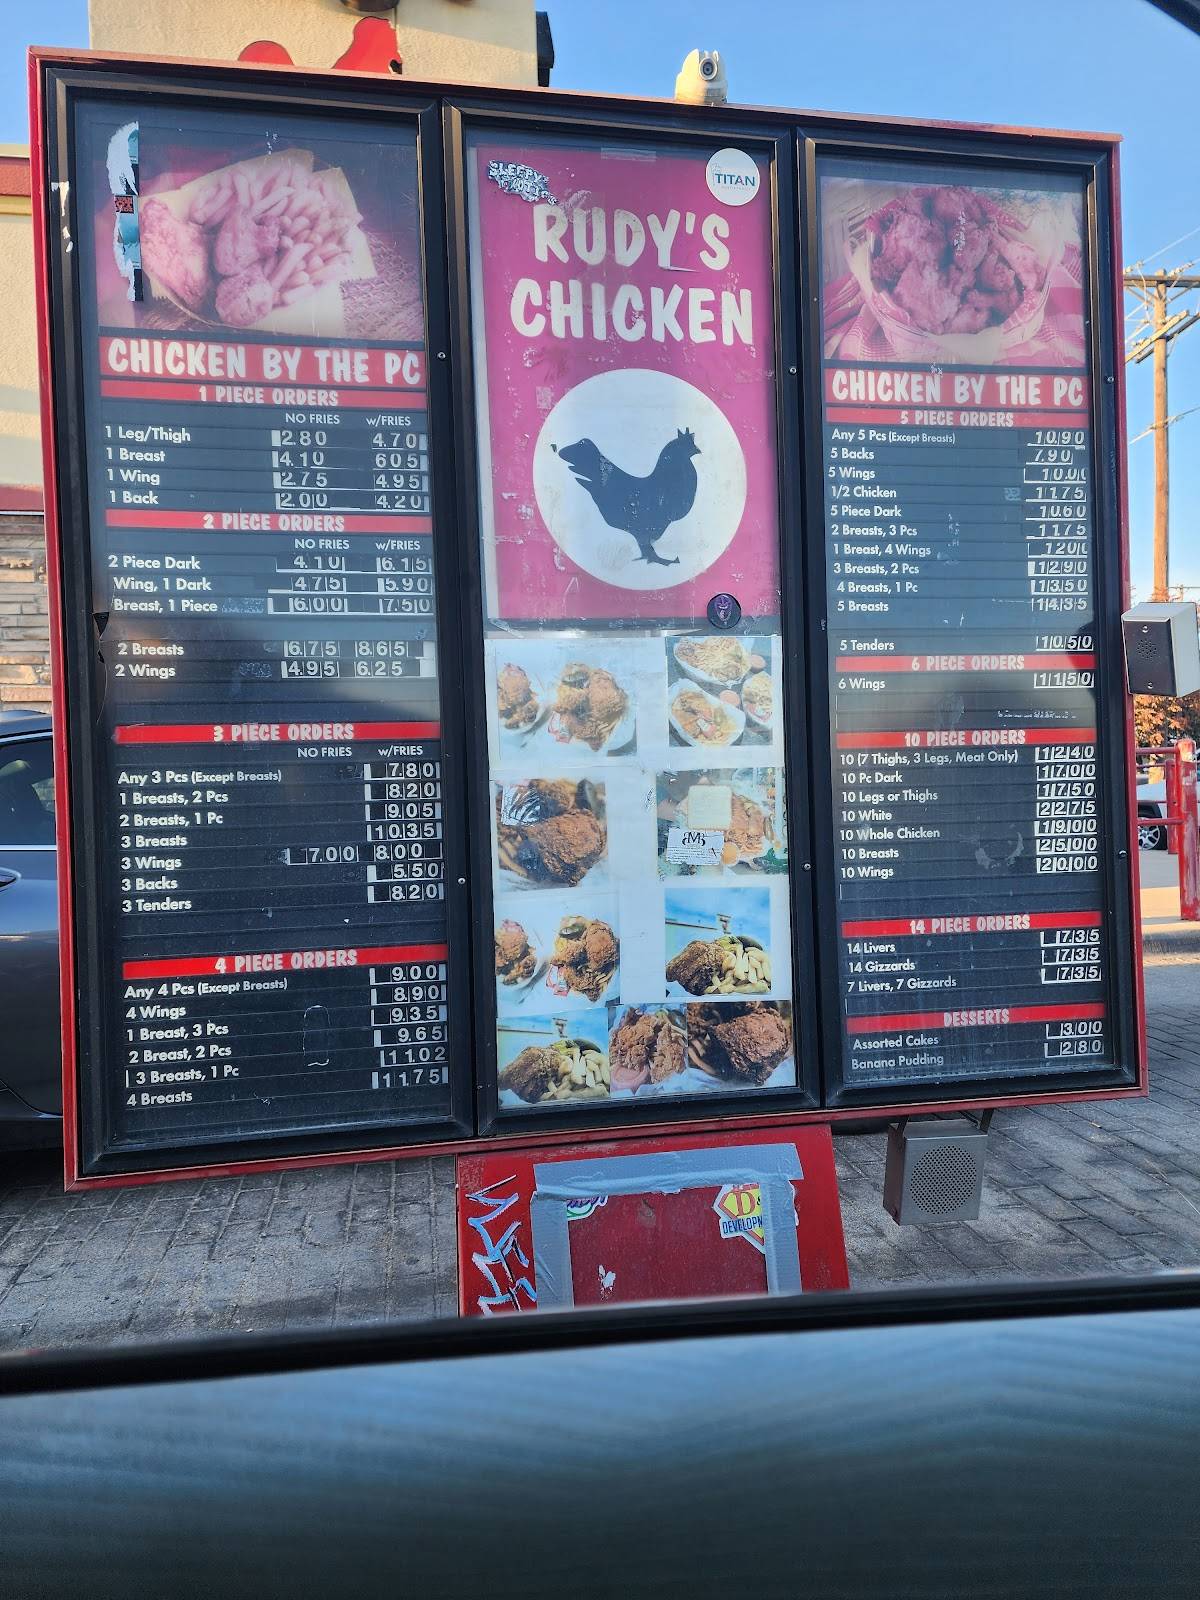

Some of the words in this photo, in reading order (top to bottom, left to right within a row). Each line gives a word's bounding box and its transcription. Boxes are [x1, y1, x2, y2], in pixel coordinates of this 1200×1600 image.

[715, 174, 755, 186] TITAN
[533, 204, 731, 271] RUDY'S
[510, 278, 754, 345] CHICKEN
[108, 338, 246, 379] CHICKEN
[262, 348, 301, 381] BY
[314, 350, 370, 383] THE
[384, 352, 421, 385] PC
[199, 385, 208, 401] 1
[216, 386, 264, 404] PIECE
[272, 388, 339, 407] ORDERS
[832, 371, 942, 403] CHICKEN
[955, 375, 985, 404] BY
[997, 377, 1041, 405] THE
[1054, 378, 1083, 406] PC
[285, 413, 306, 424] NO
[310, 414, 340, 425] FRIES
[366, 415, 411, 427] w/FRIES
[901, 412, 908, 425] 5
[915, 411, 954, 425] PIECE
[960, 412, 1013, 427] ORDERS
[106, 426, 112, 438] 1
[118, 426, 191, 442] Leg/Thigh
[831, 429, 855, 443] Any
[858, 430, 866, 441] 5
[870, 430, 886, 441] Pcs
[888, 432, 920, 444] (Except
[922, 432, 956, 443] Breasts)
[107, 448, 112, 459] 1
[120, 448, 165, 462] Breast
[108, 469, 114, 481] 1
[120, 470, 160, 485] Wing
[110, 491, 116, 502] 1
[122, 491, 158, 504] Back
[831, 486, 850, 498] 1/2
[854, 486, 896, 499] Chicken
[831, 506, 838, 516] 5
[842, 506, 871, 517] Piece
[874, 506, 902, 517] Dark
[203, 514, 214, 529] 2
[222, 513, 271, 530] PIECE
[278, 514, 345, 532] ORDERS
[295, 539, 315, 550] NO
[319, 539, 349, 550] FRIES
[375, 540, 420, 551] w/FRIES
[108, 556, 118, 568] 2
[123, 556, 161, 569] Piece
[165, 557, 200, 569] Dark
[113, 578, 158, 592] Wing,
[164, 578, 170, 590] 1
[176, 578, 211, 591] Dark
[118, 644, 128, 656] 2
[132, 643, 184, 656] Breasts
[912, 658, 920, 670] 6
[927, 656, 965, 670] PIECE
[971, 655, 1024, 670] ORDERS
[115, 664, 125, 676] 2
[129, 664, 175, 679] Wings
[839, 679, 846, 689] 6
[850, 678, 885, 691] Wings
[213, 727, 224, 741] 3
[231, 726, 279, 741] PIECE
[288, 725, 354, 740] ORDERS
[905, 733, 919, 746] 10
[927, 732, 965, 746] PIECE
[972, 730, 1025, 745] ORDERS
[298, 748, 318, 758] NO
[321, 747, 352, 757] FRIES
[378, 745, 423, 757] w/FRIES
[840, 754, 854, 765] 10
[857, 752, 869, 766] (7
[872, 752, 910, 765] Thighs,
[914, 753, 921, 763] 3
[924, 752, 952, 765] Legs,
[955, 752, 985, 763] Meat
[988, 750, 1019, 763] Only)
[118, 771, 148, 785] Any
[152, 772, 161, 783] 3
[165, 771, 188, 783] Pcs
[192, 771, 234, 784] (Except
[237, 770, 281, 782] Breasts)
[120, 793, 125, 804] 1
[132, 792, 188, 805] Breasts,
[193, 792, 202, 803] 2
[206, 792, 228, 803] Pcs
[841, 792, 855, 803] 10
[859, 791, 885, 804] Legs
[888, 793, 900, 802] or
[902, 790, 938, 802] Thighs
[841, 810, 855, 821] 10
[859, 810, 892, 821] White
[840, 829, 854, 840] 10
[858, 829, 893, 840] Whole
[898, 827, 940, 839] Chicken
[121, 857, 131, 869] 3
[135, 857, 181, 871] Wings
[841, 867, 854, 878] 10
[858, 866, 894, 879] Wings
[122, 900, 132, 912] 3
[136, 898, 192, 912] Tenders
[910, 921, 926, 935] 14
[932, 918, 970, 933] PIECE
[977, 915, 1030, 932] ORDERS
[847, 943, 862, 954] 14
[864, 941, 896, 953] Livers
[215, 957, 226, 974] 4
[234, 955, 283, 973] PIECE
[291, 951, 358, 967] ORDERS
[849, 962, 863, 973] 14
[866, 960, 915, 972] Gizzards
[124, 985, 154, 1000] Any
[158, 984, 168, 996] 4
[172, 983, 194, 995] Pcs
[198, 981, 240, 995] (Except
[243, 978, 288, 991] Breasts)
[126, 1008, 136, 1020] 4
[140, 1005, 186, 1020] Wings
[944, 1009, 1010, 1027] DESSERTS
[127, 1030, 132, 1041] 1
[140, 1027, 188, 1041] Breast,
[193, 1025, 202, 1037] 3
[206, 1023, 228, 1036] Pcs
[853, 1036, 902, 1050] Assorted
[905, 1035, 939, 1046] Cakes
[851, 1058, 896, 1070] Banana
[899, 1055, 944, 1068] Pudding
[127, 1094, 137, 1106] 4
[141, 1090, 192, 1104] Breasts
